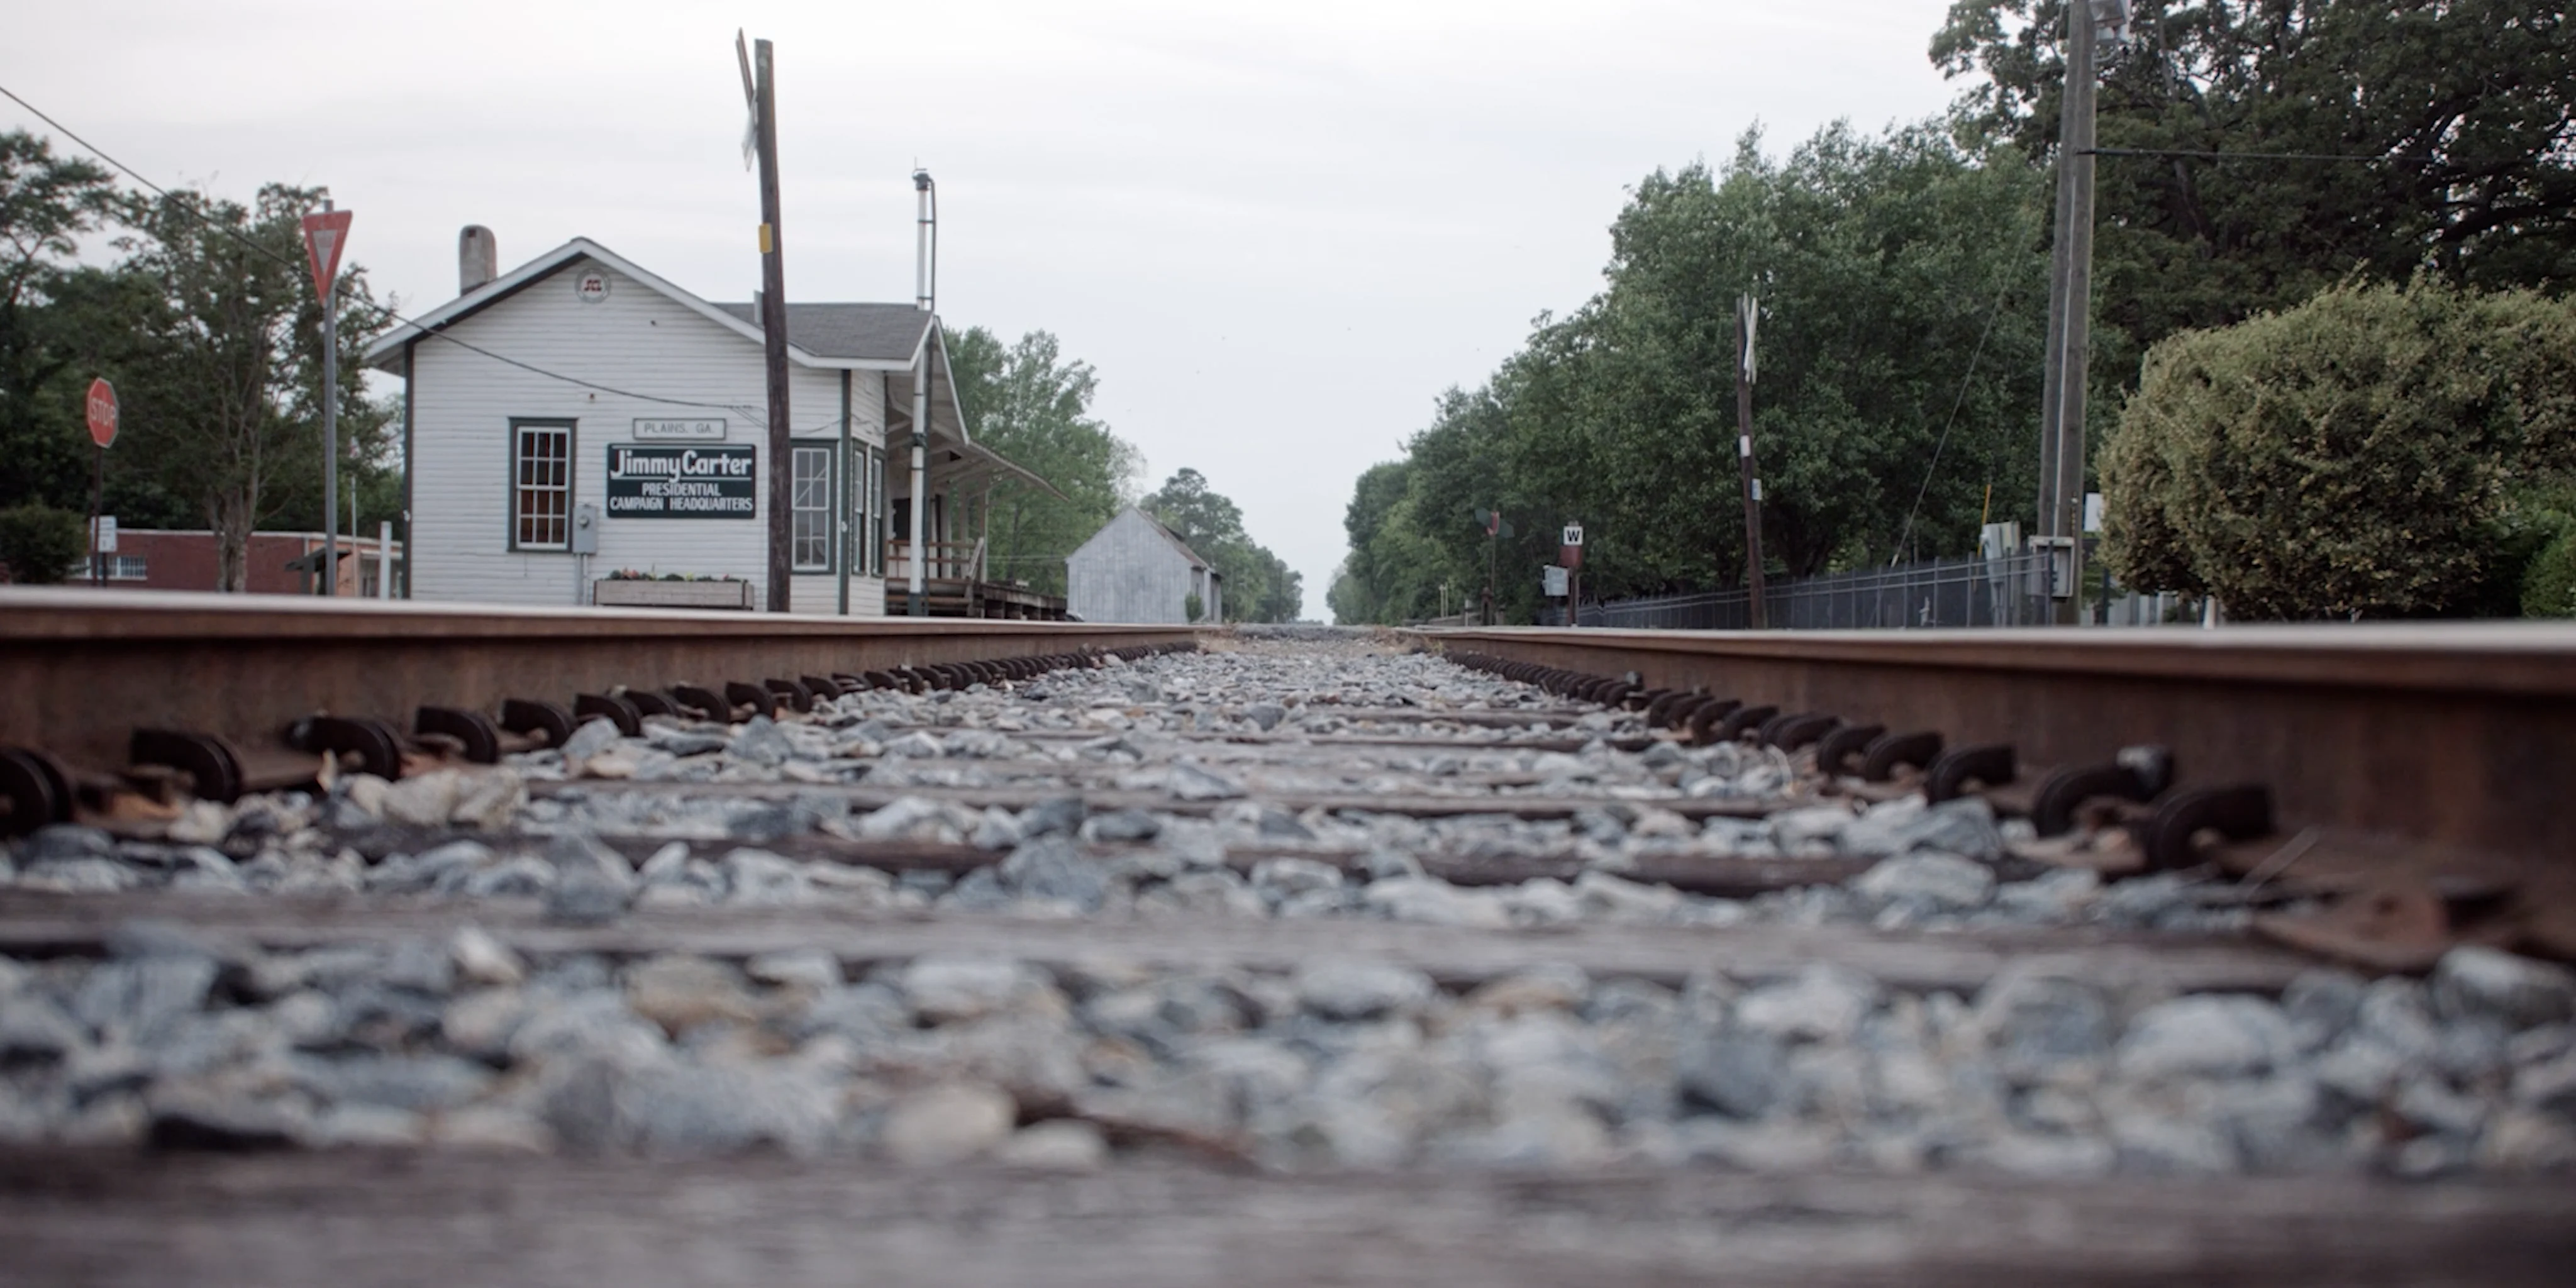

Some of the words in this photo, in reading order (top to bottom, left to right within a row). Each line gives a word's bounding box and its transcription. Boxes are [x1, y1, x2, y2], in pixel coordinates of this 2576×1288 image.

[91, 397, 116, 428] STOP
[641, 483, 721, 496] PRESIDENTIAL
[609, 497, 663, 510] CAMPAIGN
[669, 497, 753, 511] HEADQUARTERS
[1567, 530, 1580, 541] W
